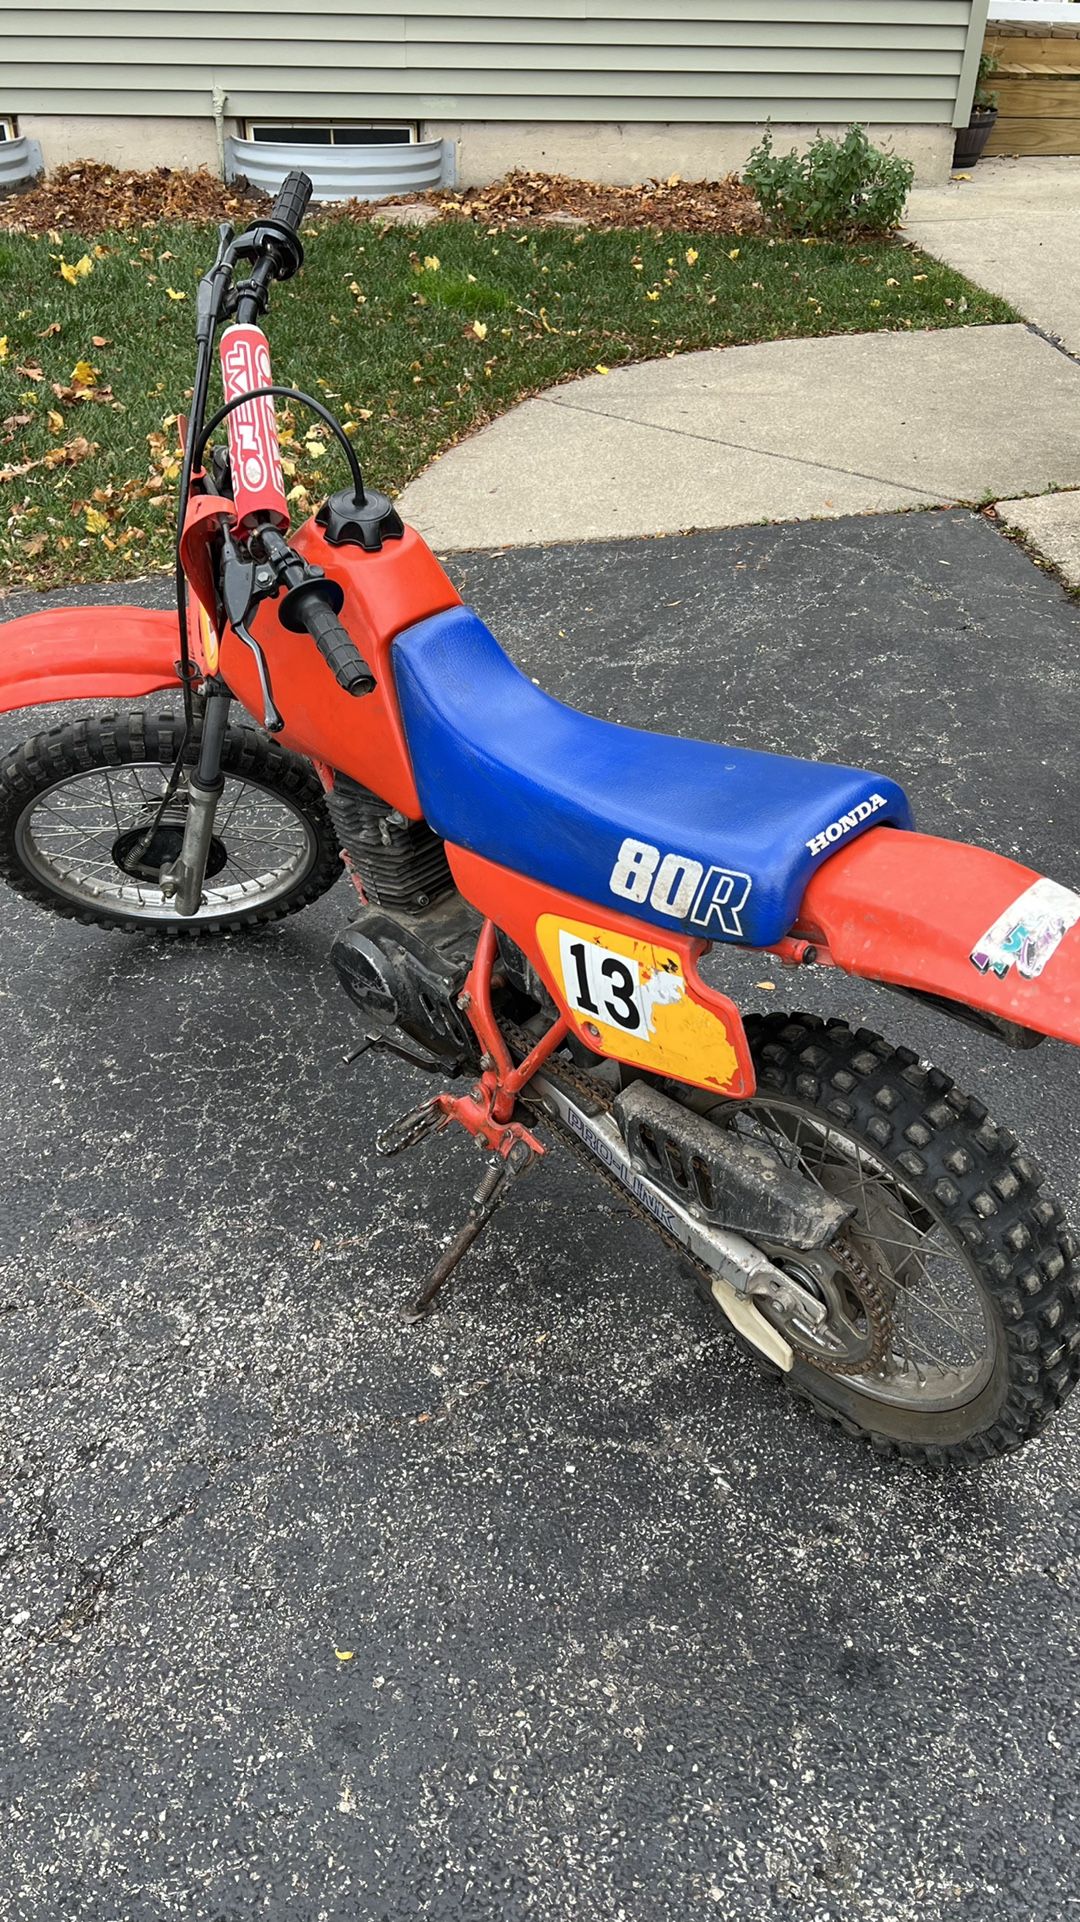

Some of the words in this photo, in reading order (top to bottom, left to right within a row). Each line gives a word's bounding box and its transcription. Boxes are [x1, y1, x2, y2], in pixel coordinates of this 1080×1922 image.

[805, 793, 887, 856] HONDA
[609, 837, 752, 936] 80R
[570, 943, 641, 1030] 13
[568, 1108, 679, 1237] PRO-LINK
